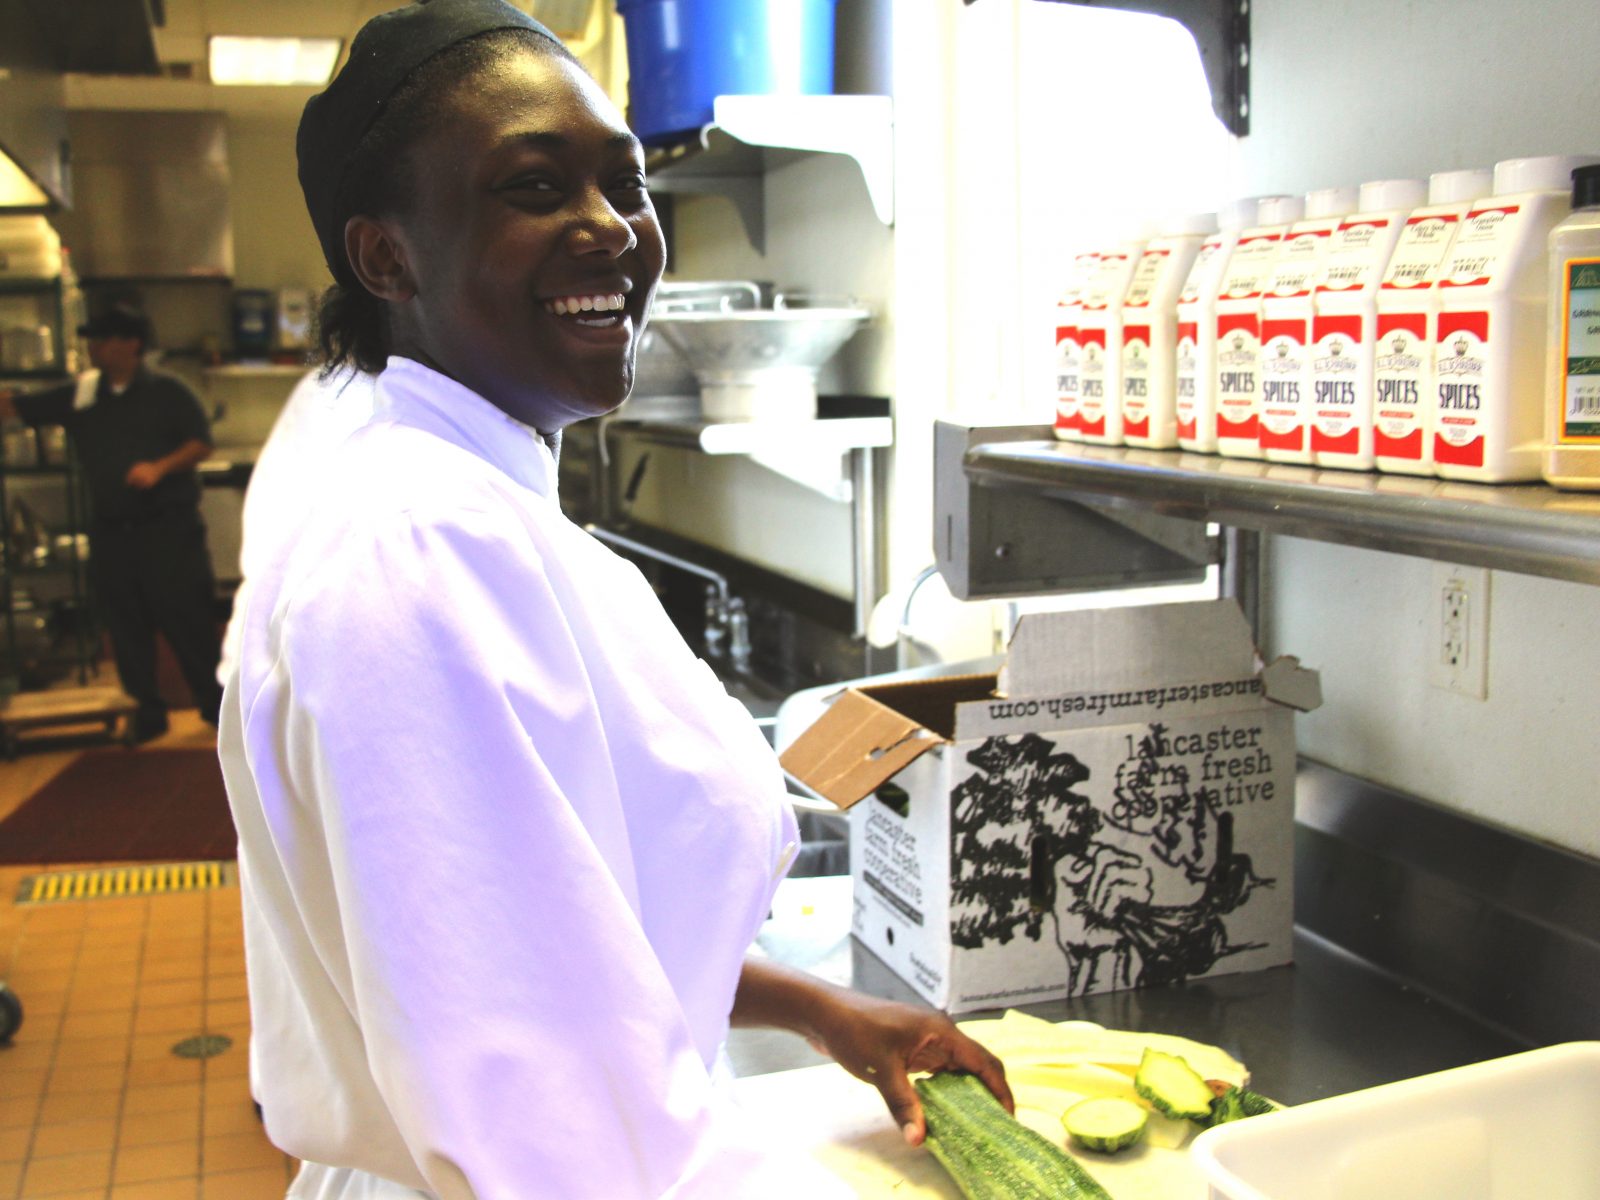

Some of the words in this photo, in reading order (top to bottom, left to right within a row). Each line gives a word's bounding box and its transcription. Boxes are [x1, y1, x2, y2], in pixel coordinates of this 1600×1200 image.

[1220, 372, 1255, 393] SPICES
[1263, 381, 1300, 403] SPICES
[1315, 380, 1355, 405] SPICES
[1377, 379, 1418, 404] SPICES
[1439, 383, 1480, 410] SPICES
[989, 678, 1263, 719] ancasterfarmfresh.com
[1126, 725, 1262, 761] lancaster
[1201, 749, 1272, 781] fresh
